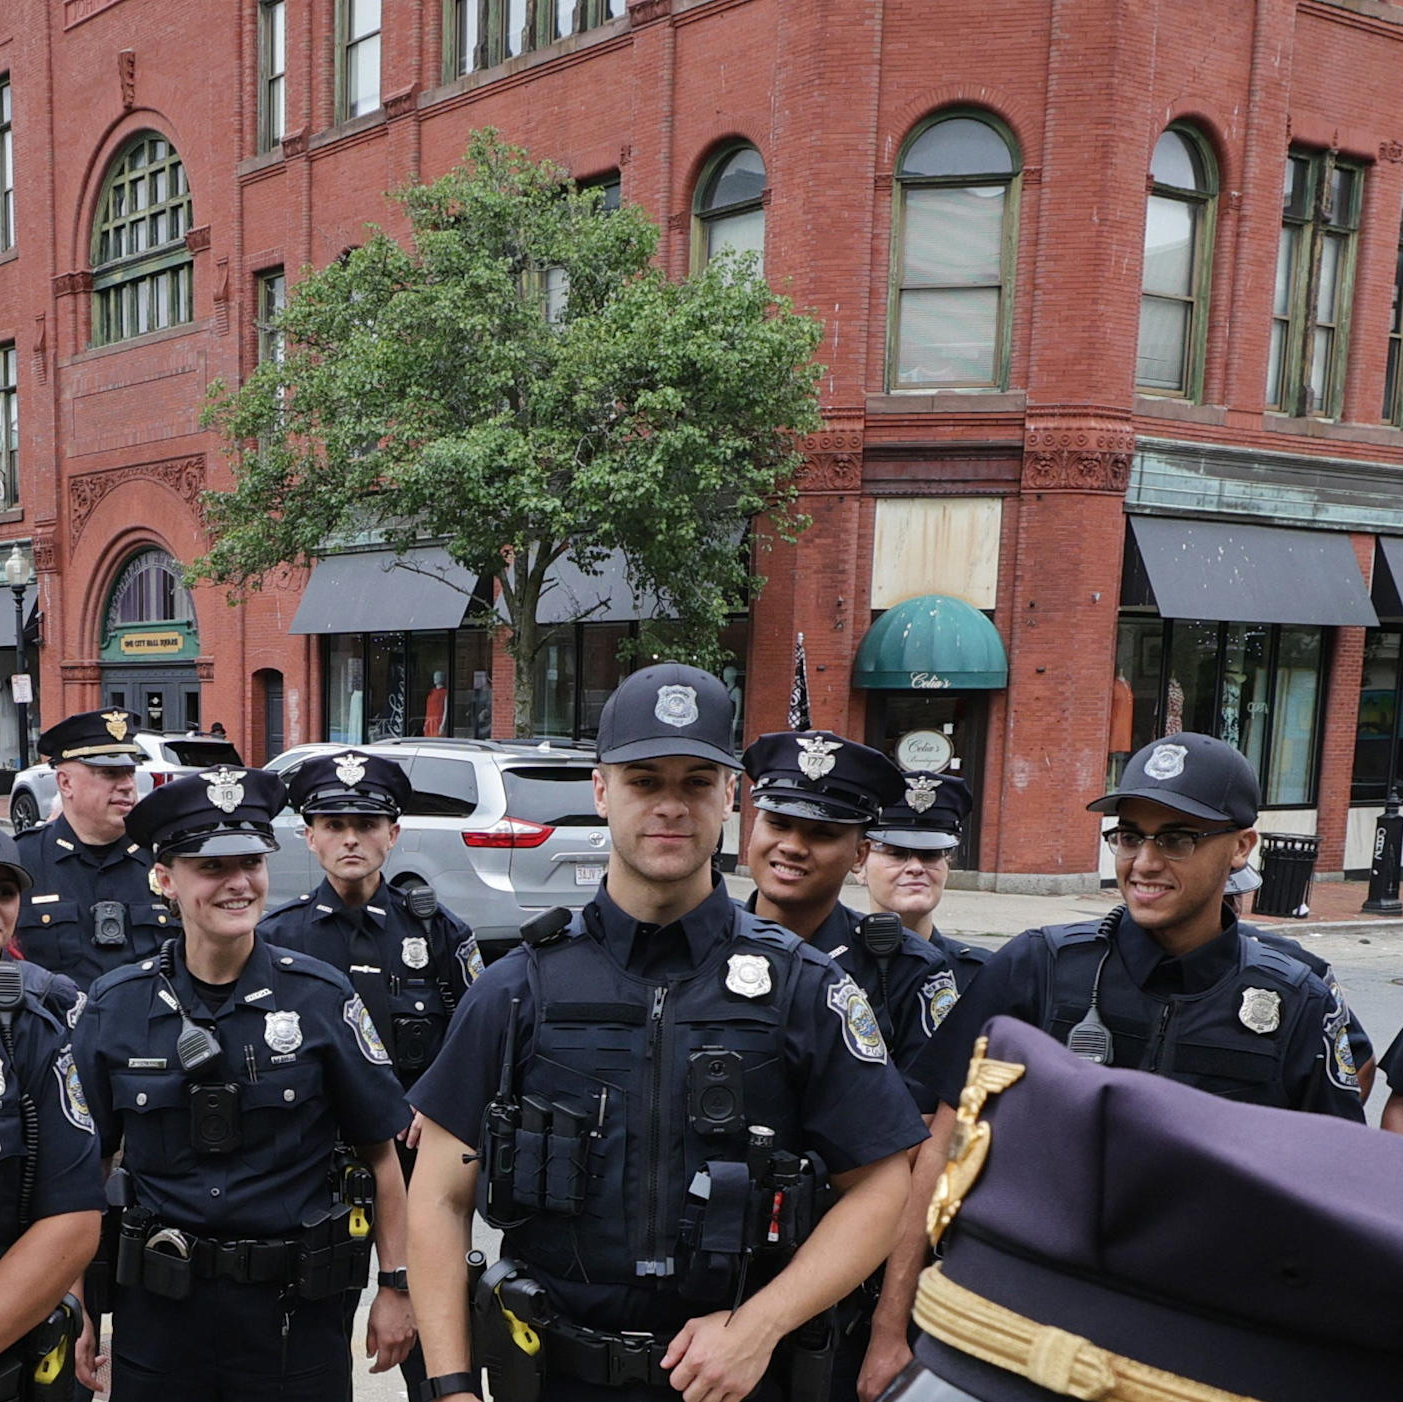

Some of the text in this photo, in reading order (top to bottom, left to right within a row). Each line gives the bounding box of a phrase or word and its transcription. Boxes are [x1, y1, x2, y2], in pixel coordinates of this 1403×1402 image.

[910, 671, 951, 689] Celia's
[907, 738, 941, 753] Celia's
[807, 757, 824, 767] 177
[222, 790, 233, 801] 10
